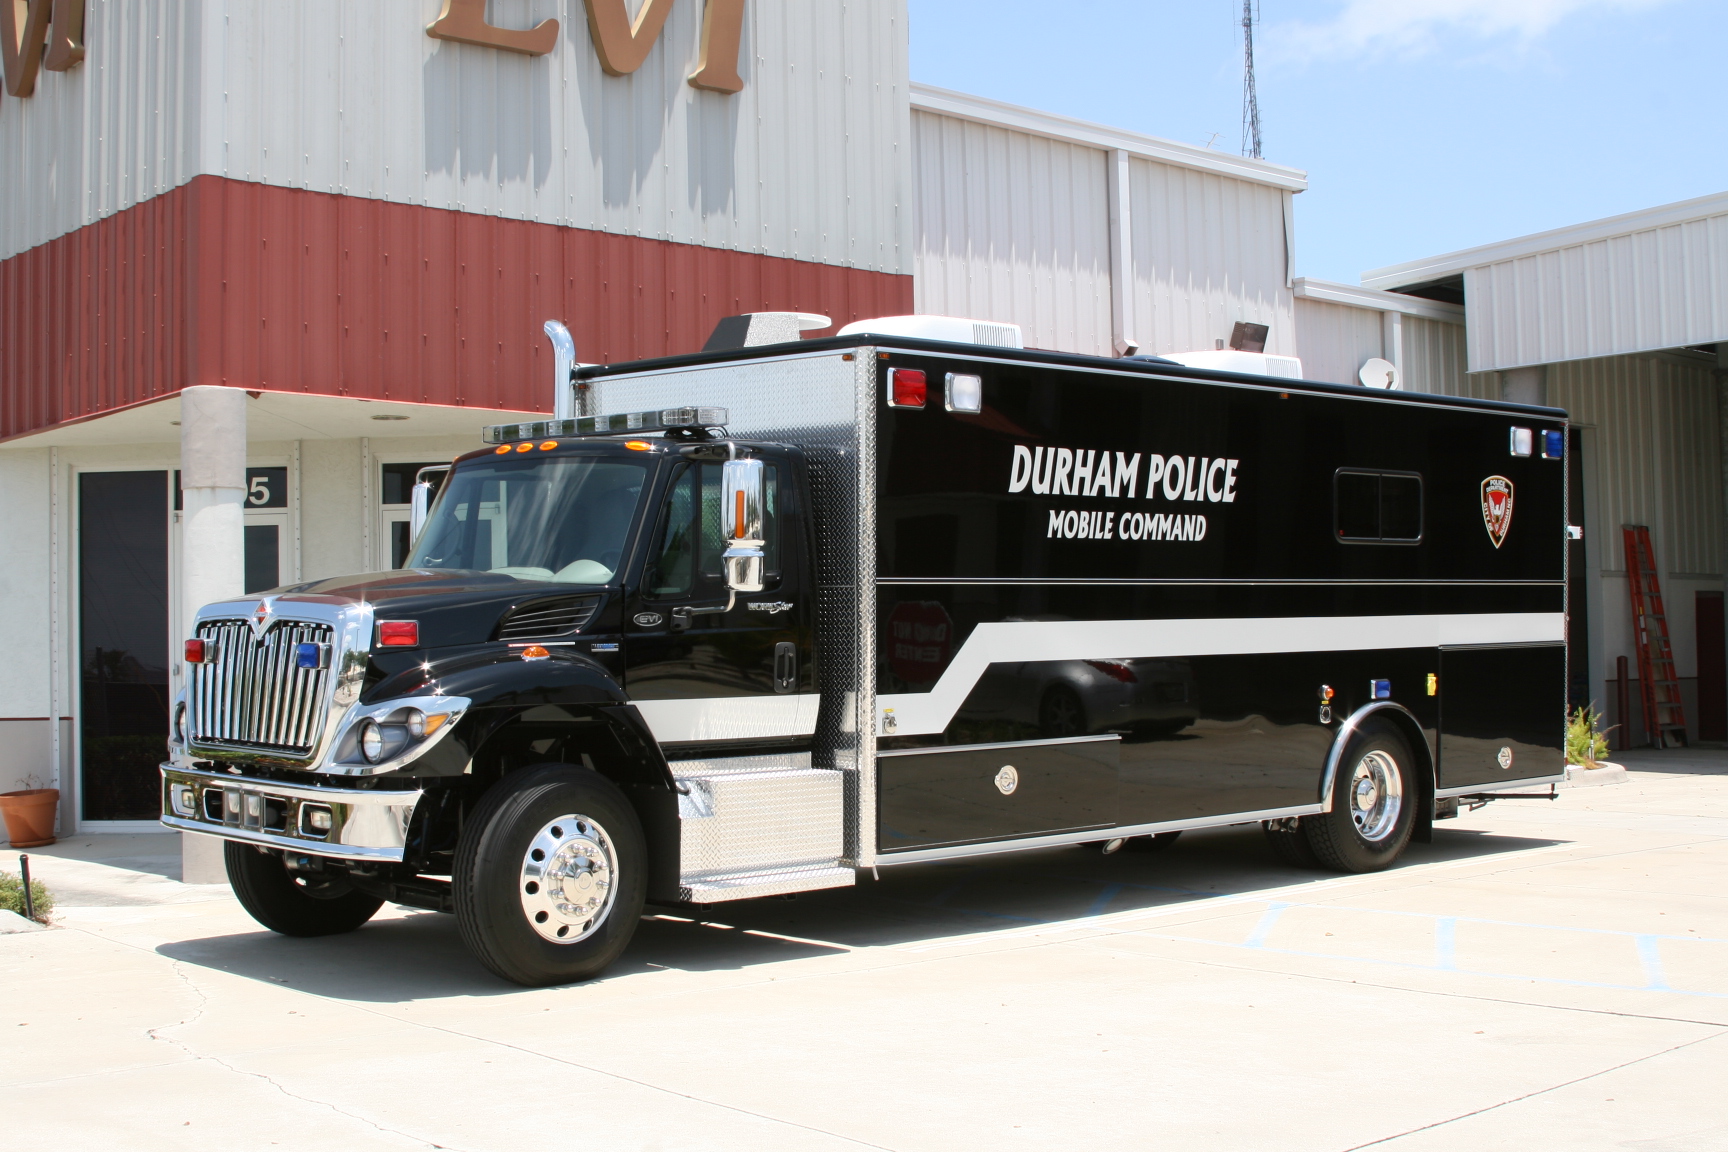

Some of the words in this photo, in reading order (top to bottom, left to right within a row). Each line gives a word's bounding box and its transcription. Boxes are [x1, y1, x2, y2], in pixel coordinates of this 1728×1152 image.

[1008, 444, 1141, 498] DURHAM
[1146, 453, 1239, 503] POLICE
[1490, 479, 1505, 487] POLICE
[245, 476, 270, 505] 5
[1047, 509, 1115, 540] MOBILE
[1118, 512, 1207, 541] COMMAND
[640, 614, 659, 623] EVI
